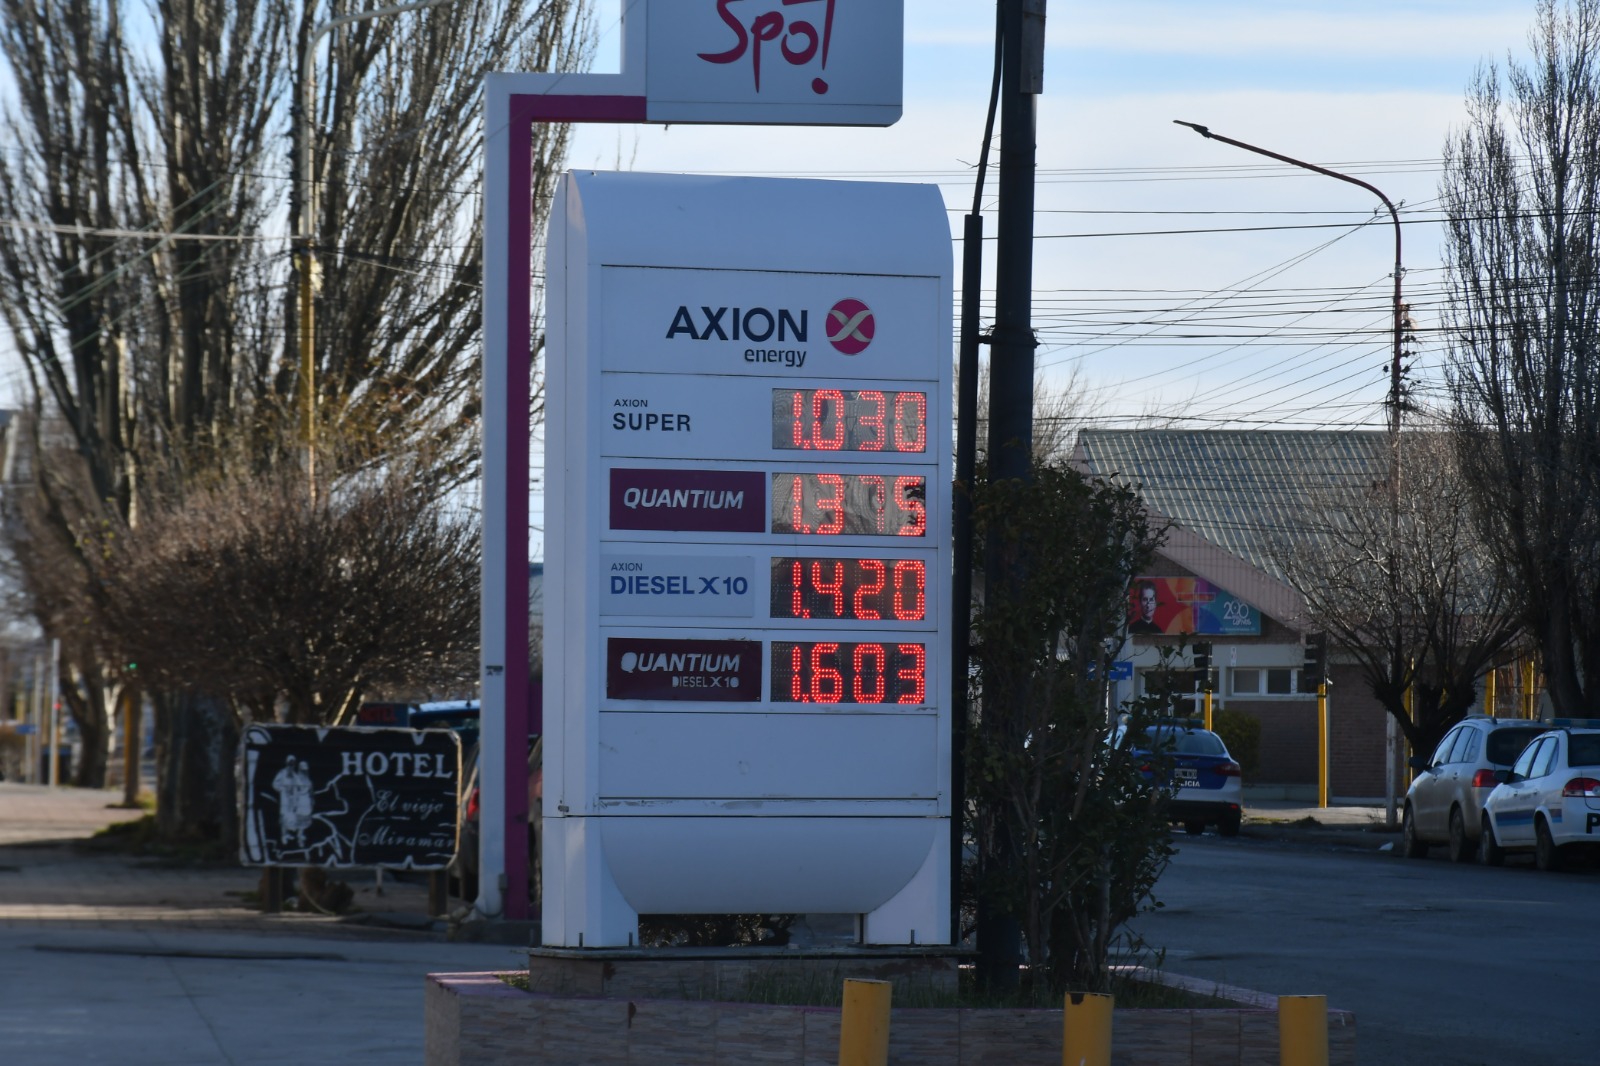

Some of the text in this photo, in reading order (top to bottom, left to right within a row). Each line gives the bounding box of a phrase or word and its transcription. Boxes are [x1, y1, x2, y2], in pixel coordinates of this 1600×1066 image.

[666, 305, 808, 342] AXION
[744, 347, 807, 368] energy
[613, 399, 648, 408] AXION
[612, 412, 691, 432] SUPER
[793, 389, 926, 453] 1.030
[623, 487, 744, 509] QUANTIUM
[793, 473, 926, 536] 1.375
[610, 562, 643, 572] AXION
[791, 559, 926, 620] 1.420
[620, 651, 740, 673] QUANTIUM
[791, 643, 926, 704] 1.603
[341, 751, 453, 778] HOTEL
[376, 789, 444, 821] El viejo
[358, 825, 455, 847] Miramar
